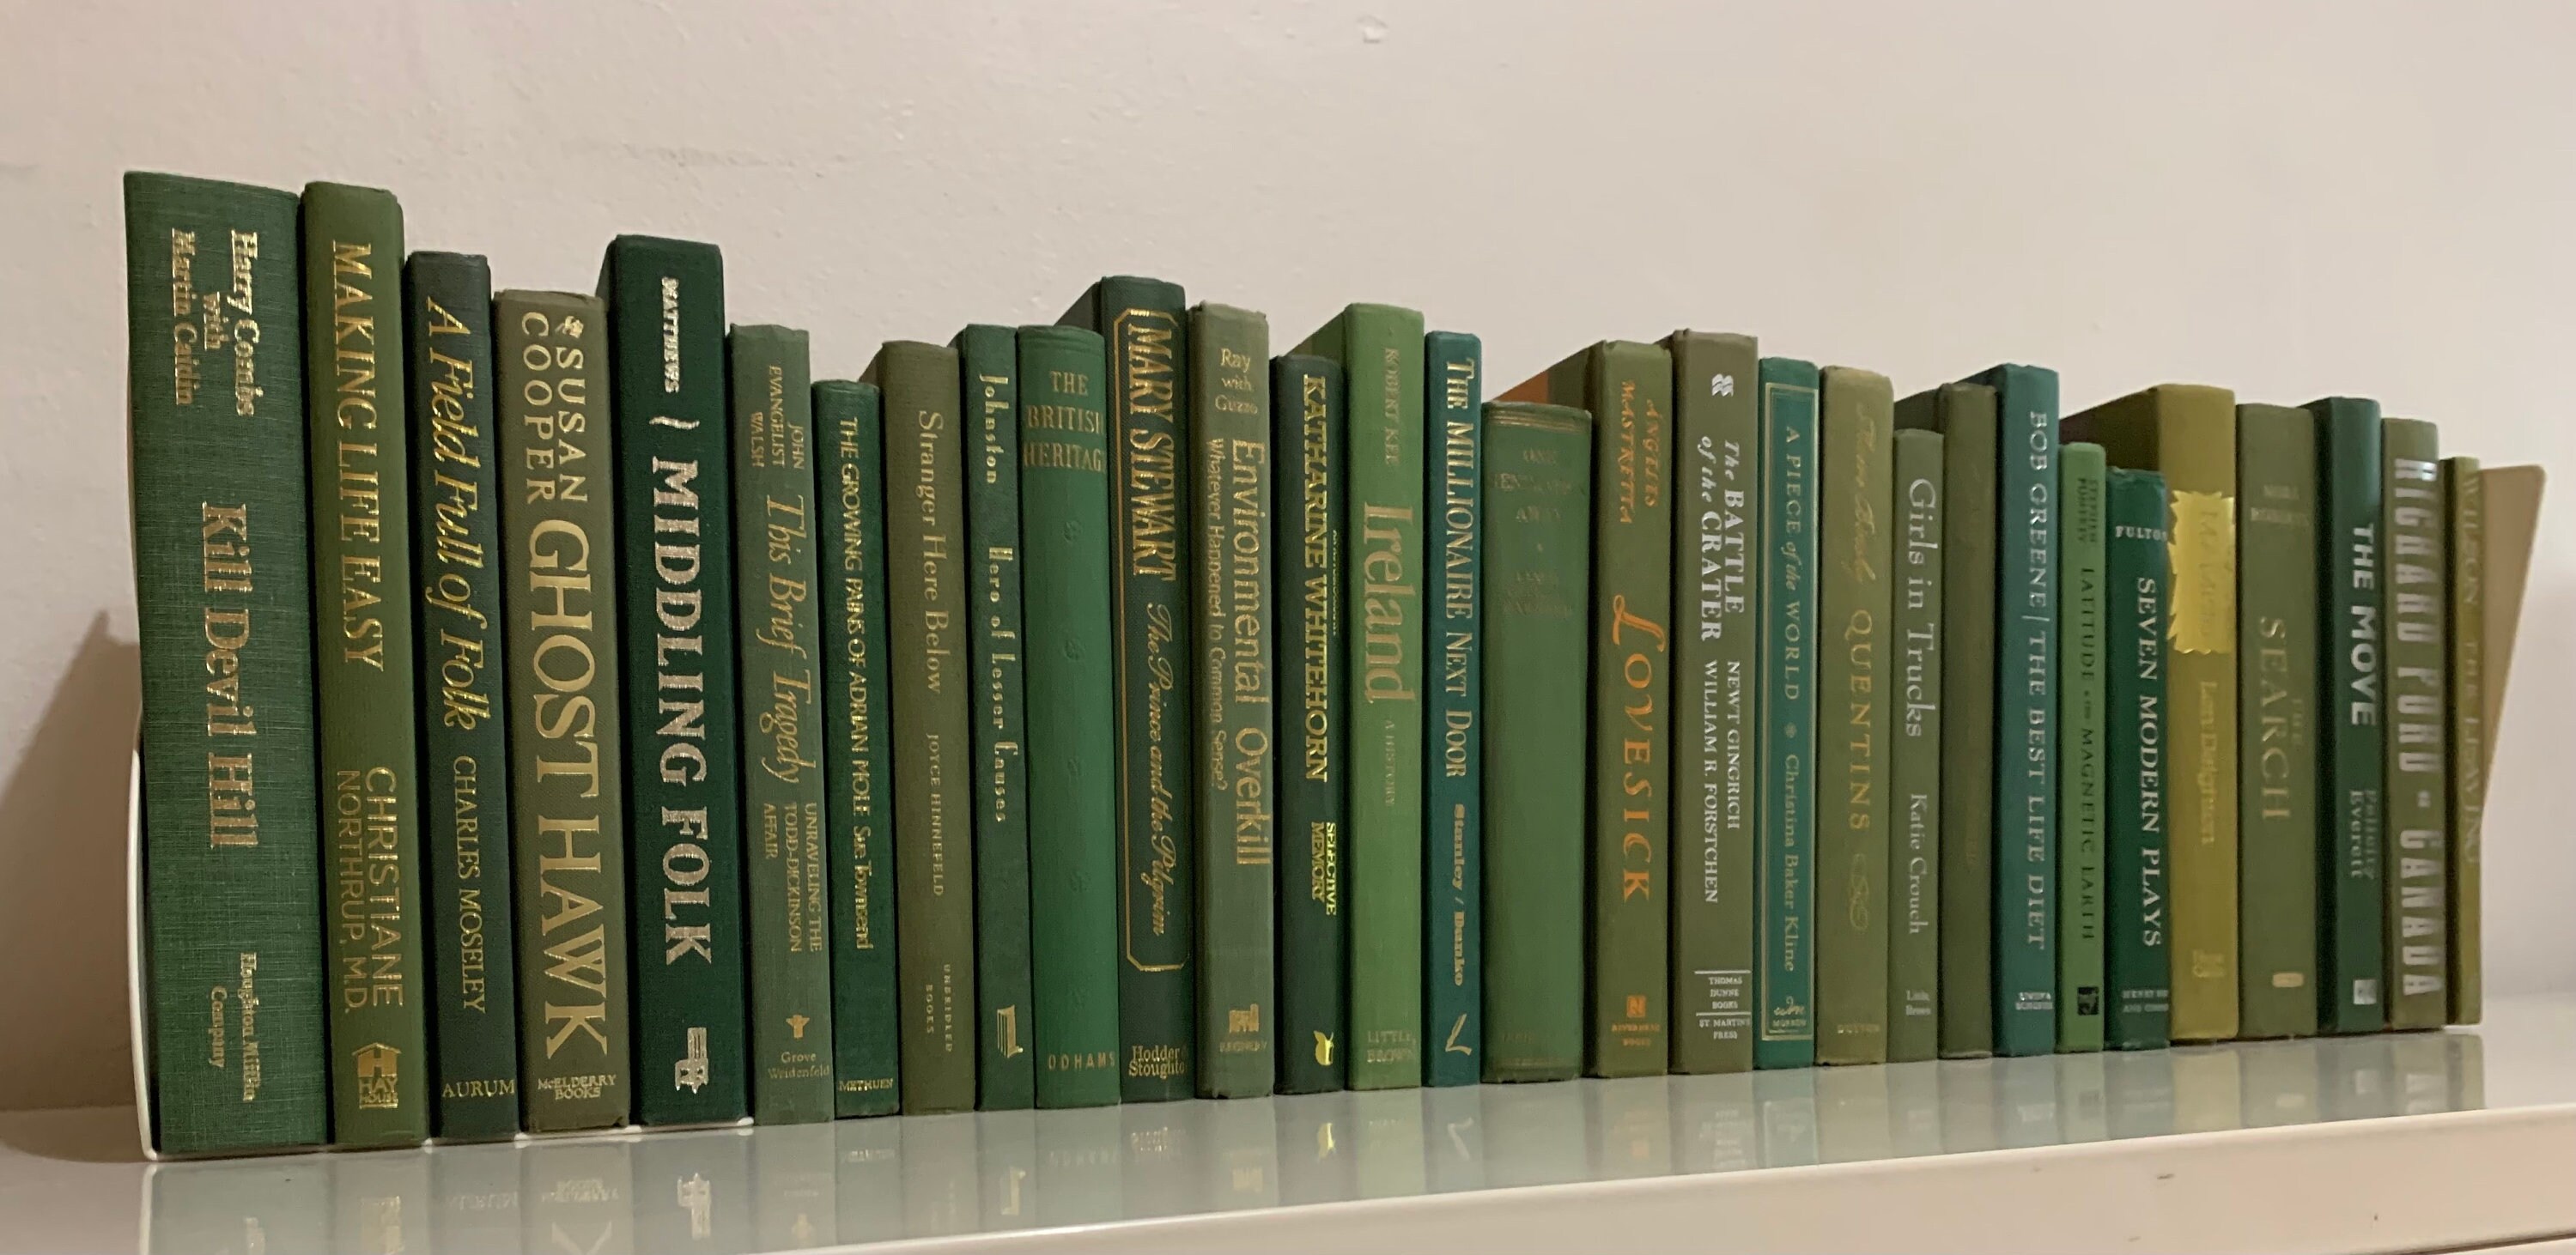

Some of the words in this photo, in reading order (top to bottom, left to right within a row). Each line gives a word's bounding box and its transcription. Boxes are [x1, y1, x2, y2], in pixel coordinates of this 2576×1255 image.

[172, 227, 198, 318] Martin
[228, 229, 258, 316] Harry
[427, 295, 471, 336] A
[203, 291, 230, 351] with
[331, 239, 378, 430] MAKING
[661, 276, 680, 393] MATTHEWS
[1220, 348, 1252, 374] Ray
[174, 322, 201, 407] Caidin
[234, 318, 265, 417] Combs
[1049, 370, 1090, 397] THE
[1127, 323, 1174, 423] MARY
[1214, 393, 1260, 415] Guzzo
[1221, 374, 1253, 392] with
[1383, 347, 1400, 423] ROBERT
[1446, 356, 1476, 410] THE
[429, 347, 481, 470] Field
[520, 311, 557, 506] COOPER
[555, 346, 588, 503] SUSAN
[750, 410, 765, 469] WALSH
[769, 365, 786, 469] EVANGELIST
[787, 420, 805, 470] JOHN
[839, 415, 860, 459] THE
[979, 373, 1011, 484] Johnston
[1697, 435, 1717, 464] of
[1785, 425, 1801, 445] A
[2029, 409, 2049, 471] BOB
[337, 441, 380, 543] LIFE
[915, 410, 945, 527] Stranger
[1206, 438, 1225, 520] Whatever
[1303, 373, 1327, 569] KATHARINE
[1701, 465, 1717, 504] the
[1723, 439, 1741, 482] The
[1785, 453, 1802, 536] PIECE
[201, 501, 253, 594] Kill
[436, 470, 484, 569] Full
[766, 494, 808, 565] This
[841, 462, 865, 572] GROWING
[1128, 427, 1177, 582] STEWART
[1445, 420, 1475, 620] MILLIONAIRE
[1907, 477, 1939, 566] Girls
[2028, 482, 2049, 609] GREENE
[923, 533, 949, 602] Here
[988, 546, 1014, 603] Hero
[1207, 524, 1226, 618] Happened
[1231, 439, 1270, 705] Environmental
[1701, 510, 1723, 642] CRATER
[1724, 488, 1746, 615] BATTLE
[1781, 540, 1802, 567] of
[1785, 563, 1801, 591] the
[1907, 576, 1933, 610] in
[2352, 522, 2375, 591] THE
[2394, 457, 2439, 643] RICHARD
[342, 555, 385, 672] EASY
[425, 573, 488, 630] of
[651, 455, 708, 787] MIDDLING
[756, 573, 809, 660] Brief
[845, 578, 866, 635] PAINS
[990, 615, 1017, 640] of
[1146, 603, 1174, 655] The
[1208, 623, 1225, 642] to
[1363, 501, 1417, 705] Ireland
[2080, 567, 2097, 682] LATITUDE
[2136, 576, 2159, 682] SEVEN
[204, 609, 258, 737] Devil
[440, 632, 492, 731] Folk
[528, 518, 600, 798] GHOST
[848, 637, 867, 668] OF
[924, 610, 951, 694] Below
[992, 652, 1017, 731] Lesser
[1209, 646, 1227, 725] Common
[1304, 573, 1328, 783] WHITEHORN
[1445, 631, 1473, 698] NEXT
[1727, 659, 1741, 725] NEWT
[1783, 599, 1801, 701] WORLD
[1905, 621, 1936, 737] Trucks
[2028, 629, 2048, 697] THE
[2350, 604, 2378, 726] MOVE
[759, 669, 817, 785] Tragedy
[848, 670, 871, 753] ADRIAN
[1148, 655, 1175, 742] Prince
[1704, 659, 1718, 754] WILLIAM
[1844, 609, 1873, 832] QUENTINS
[2259, 615, 2291, 819] SEARCH
[925, 732, 942, 788] JOYCE
[994, 741, 1019, 823] Causes
[1150, 744, 1173, 800] and
[1445, 709, 1473, 779] DOOR
[1611, 593, 1667, 903] LOVESICK
[1726, 728, 1741, 831] GINGRICH
[2027, 706, 2047, 786] BEST
[2139, 694, 2160, 834] MODERN
[208, 752, 258, 850] Hill
[452, 755, 480, 881] CHARLES
[852, 759, 872, 817] MOLE
[1235, 727, 1273, 865] Overkill
[1783, 753, 1801, 848] Christina
[1910, 792, 1929, 851] Katie
[2027, 794, 2046, 864] LIFE
[2080, 727, 2096, 855] MAGNETIC
[763, 803, 780, 860] AFFAIR
[804, 802, 823, 914] UNRAVELING
[929, 792, 945, 897] HINNEFELD
[1311, 822, 1327, 903] MEMORY
[1325, 822, 1338, 916] SELECTIVE
[1452, 803, 1466, 891] Stanley
[1704, 782, 1719, 904] FORSTCHEN
[364, 767, 404, 1007] CHRISTIANE
[661, 805, 713, 966] FOLK
[783, 801, 802, 953] TODD-DICKINSON
[1140, 834, 1177, 937] Pilgrim
[1783, 853, 1800, 910] Baker
[1909, 857, 1929, 935] Crouch
[2027, 874, 2045, 951] DIET
[2142, 847, 2162, 948] PLAYS
[2399, 829, 2445, 997] CANADA
[456, 888, 487, 1015] MOSELEY
[537, 815, 608, 1060] HAWK
[808, 916, 823, 953] THE
[1453, 910, 1466, 987] Danko
[1783, 915, 1800, 973] Kline
[343, 955, 369, 1014] M.D.
[1708, 976, 1743, 986] THOMAS
[358, 1076, 398, 1093] HAY
[441, 1078, 515, 1098] AURUM
[538, 1074, 617, 1090] McELDERRY
[555, 1086, 602, 1100] BOOKS
[780, 1051, 817, 1064] Grove
[838, 1077, 895, 1093] METHUEN
[1047, 1051, 1115, 1071] ODHAMS
[1132, 1044, 1182, 1063] Hodder
